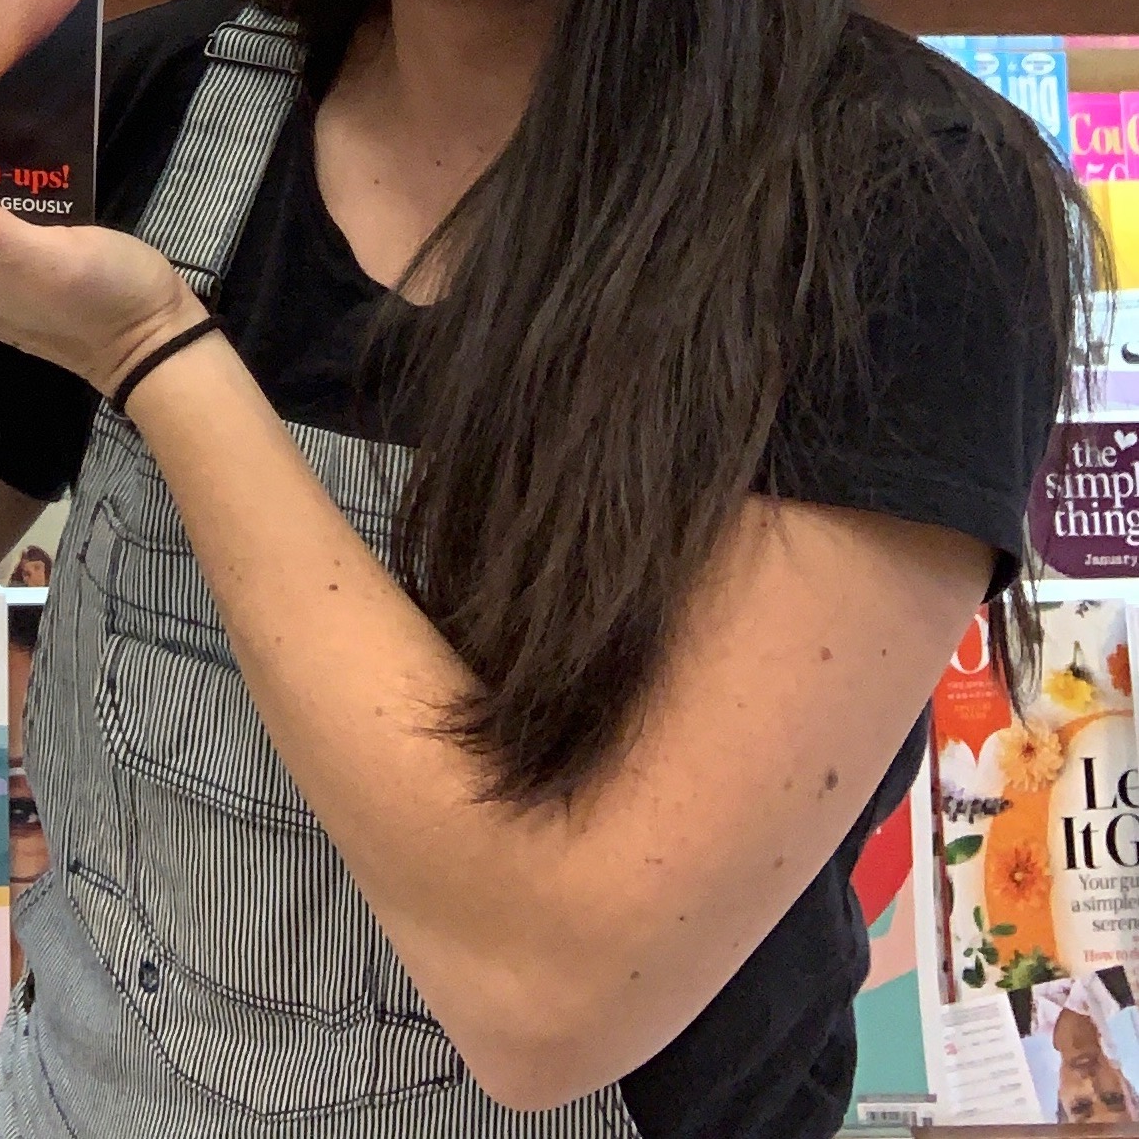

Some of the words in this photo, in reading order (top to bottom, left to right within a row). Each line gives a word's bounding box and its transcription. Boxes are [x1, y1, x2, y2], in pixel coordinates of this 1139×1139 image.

[1072, 438, 1117, 469] the
[1061, 816, 1102, 870] It
[1079, 873, 1115, 891] Your
